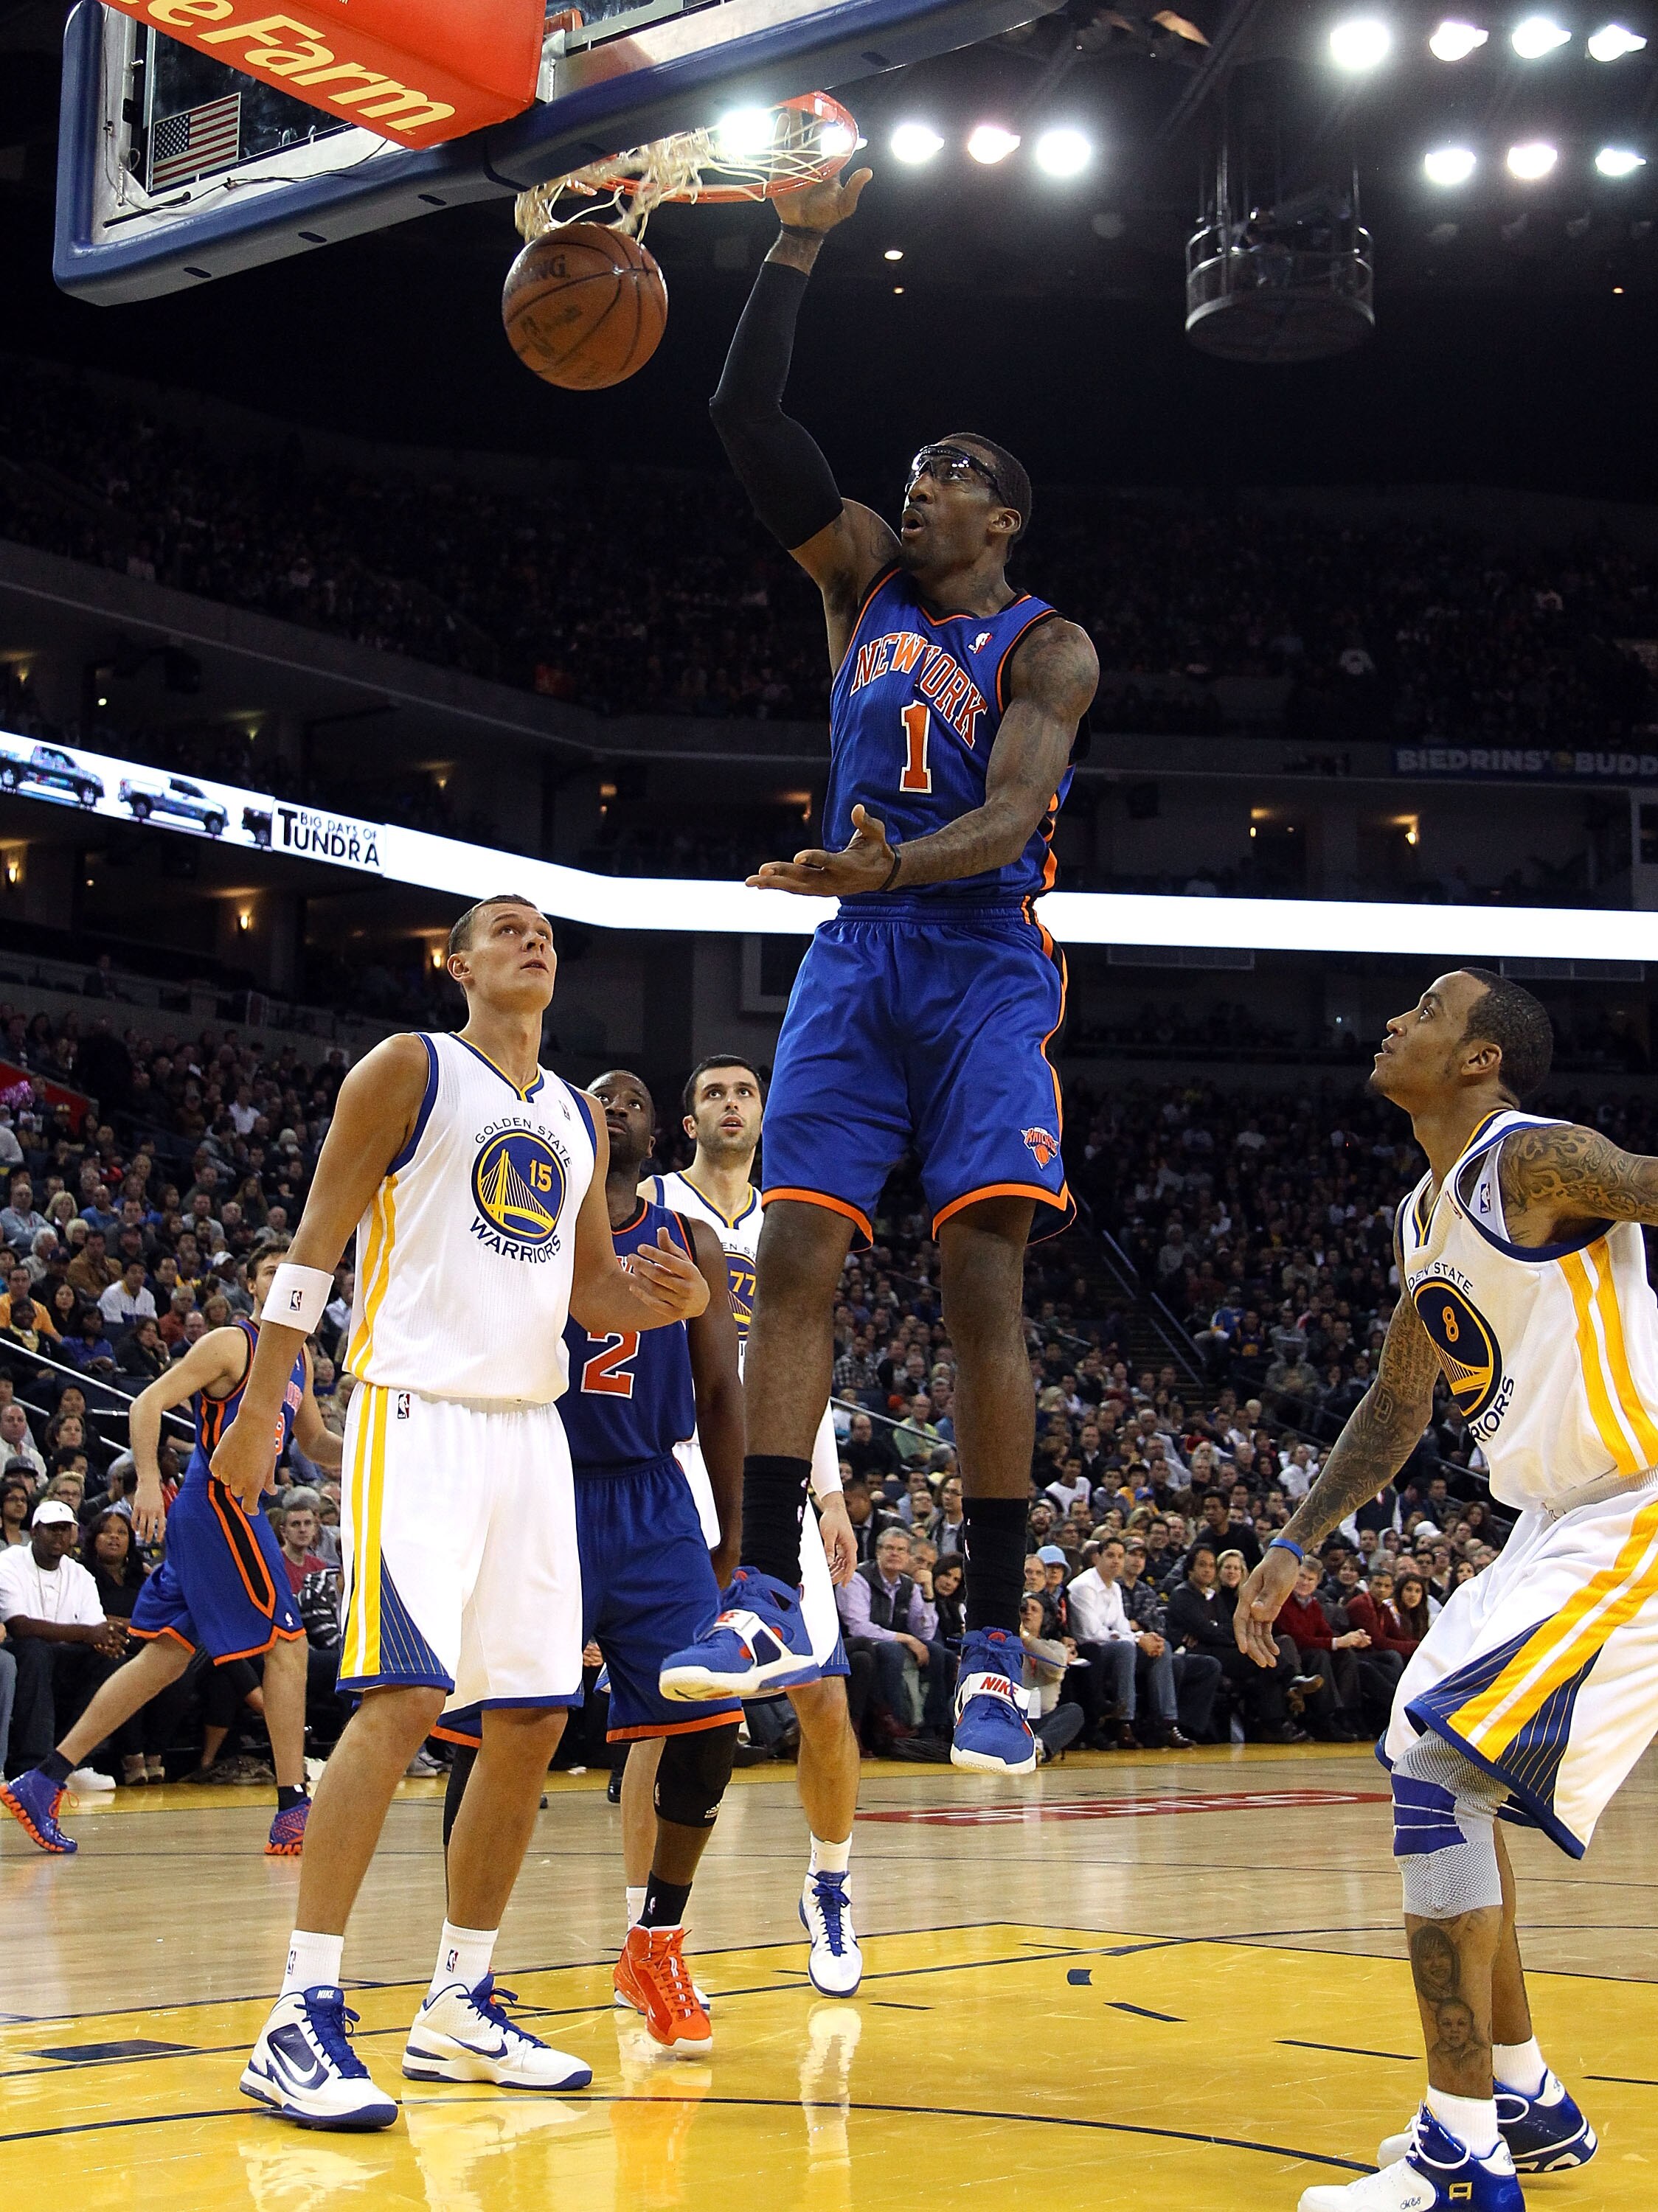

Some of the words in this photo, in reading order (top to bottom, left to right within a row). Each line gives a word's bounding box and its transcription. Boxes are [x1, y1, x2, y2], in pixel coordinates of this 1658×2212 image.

[197, 14, 455, 131] Farm
[850, 632, 927, 697] NEW
[914, 644, 988, 750] YORK
[900, 700, 932, 793] 1
[278, 808, 380, 866] TUNDRA
[301, 812, 322, 829] BIG
[328, 820, 358, 840] DAYS
[364, 828, 378, 841] OF
[475, 1118, 532, 1144] GOLDEN
[537, 1125, 572, 1169] STATE
[530, 1159, 552, 1192] 15
[470, 1216, 561, 1264] WARRIORS
[730, 1270, 757, 1295] 77
[1434, 1262, 1473, 1295] STATE
[1442, 1306, 1460, 1343] 8
[580, 1331, 640, 1399] 2
[979, 1676, 1019, 1697] NIKE
[316, 1990, 335, 1999] NIKE
